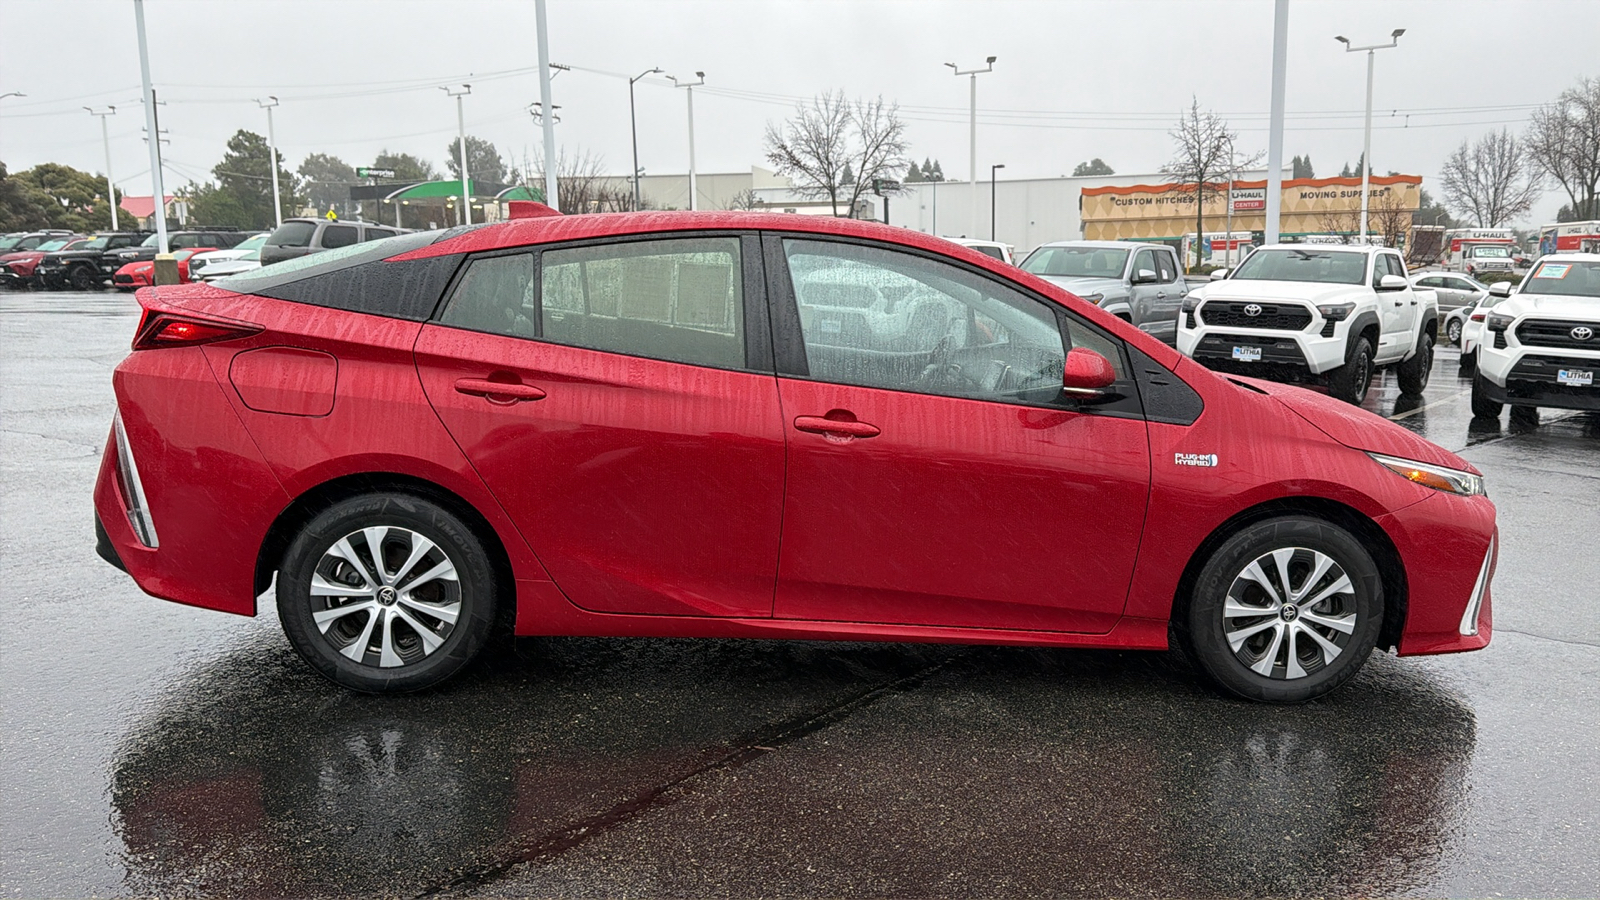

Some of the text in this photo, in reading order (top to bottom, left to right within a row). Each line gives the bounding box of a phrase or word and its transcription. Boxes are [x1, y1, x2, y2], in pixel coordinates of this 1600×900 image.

[1300, 189, 1385, 199] MOVING SUPPIES
[1115, 196, 1195, 206] CUSTOM HITCHES
[1567, 371, 1591, 379] LITHIA
[1174, 459, 1209, 467] HYBRID
